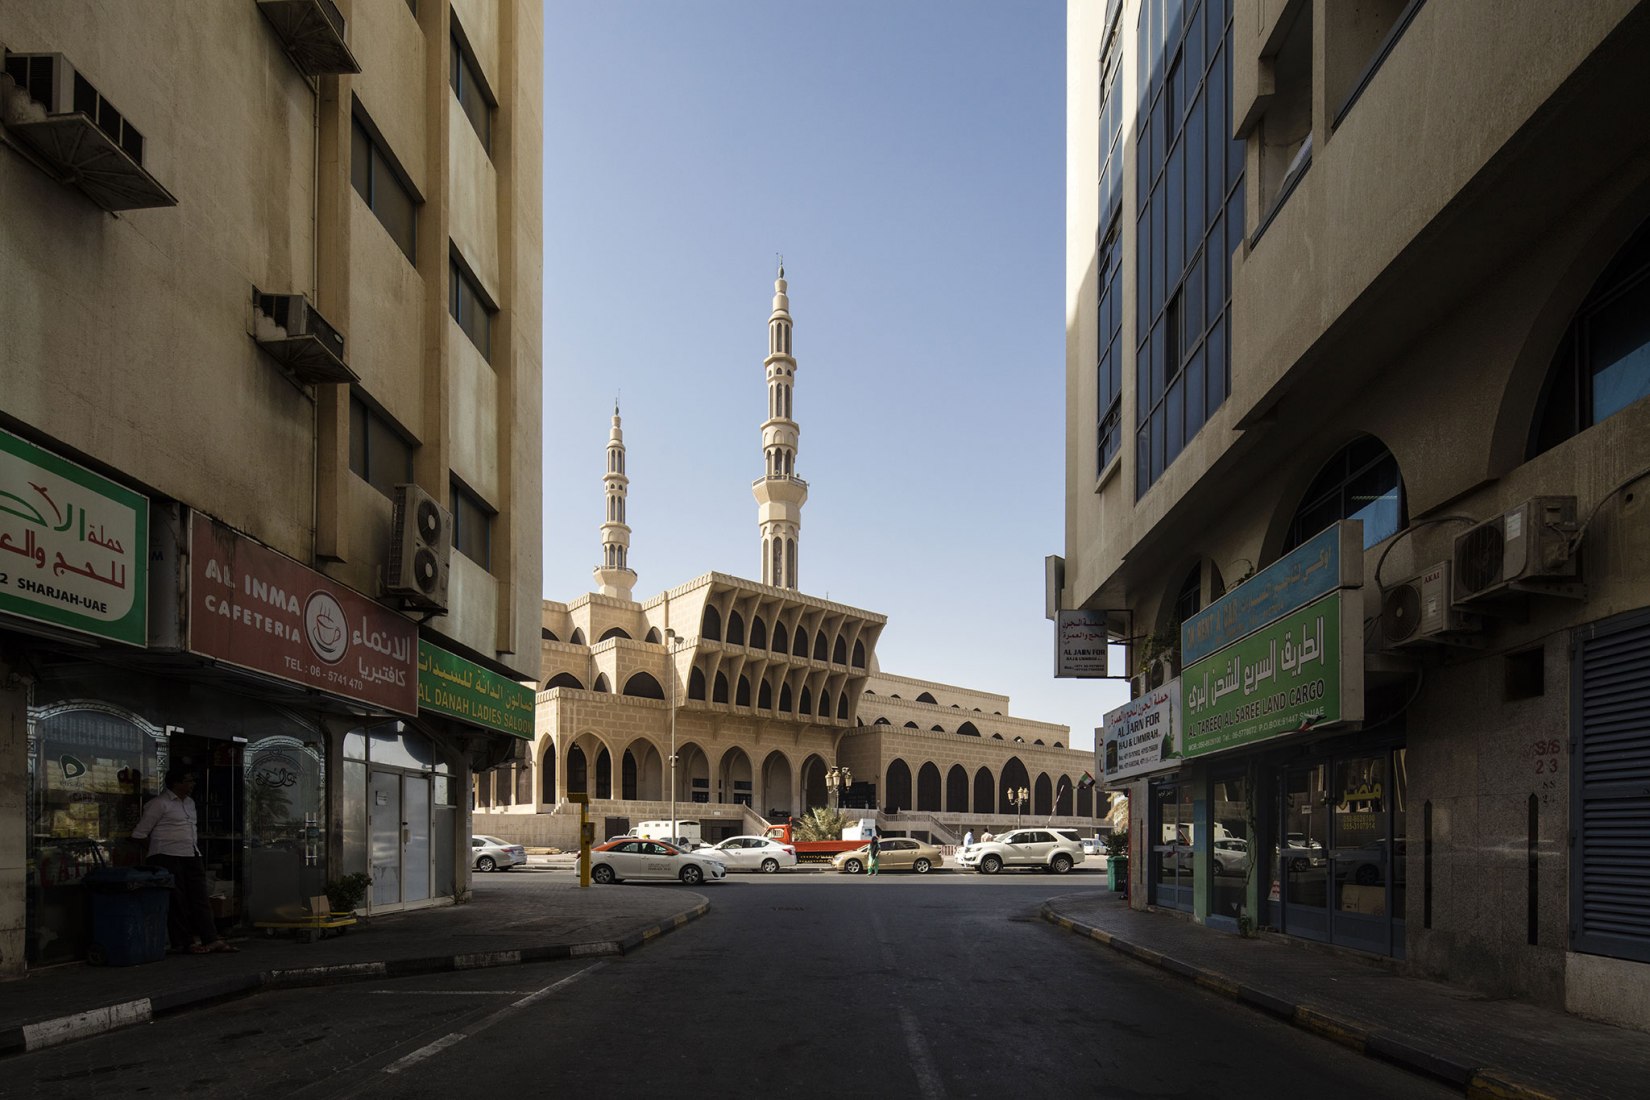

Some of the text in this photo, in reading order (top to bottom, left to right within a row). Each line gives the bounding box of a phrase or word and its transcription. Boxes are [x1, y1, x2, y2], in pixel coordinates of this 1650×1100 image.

[0, 529, 125, 589] للحج والع
[88, 524, 125, 554] حملة
[17, 578, 108, 613] SHARJAH-UAE
[204, 558, 302, 616] AL INMA
[204, 594, 302, 644] CAFETERIA
[1244, 639, 1277, 696] السريع
[1281, 616, 1325, 677] الطريق
[358, 656, 406, 688] كافتيريا
[435, 688, 470, 715] DANAH
[472, 701, 502, 725] LADIES
[504, 713, 533, 735] SALOON
[1118, 711, 1160, 738] AL JARN FOR
[1188, 679, 1325, 738] AL TAREEQ AL SAREE LAND CARGO
[1118, 740, 1128, 751] HAJ
[1338, 783, 1382, 810] مصر
